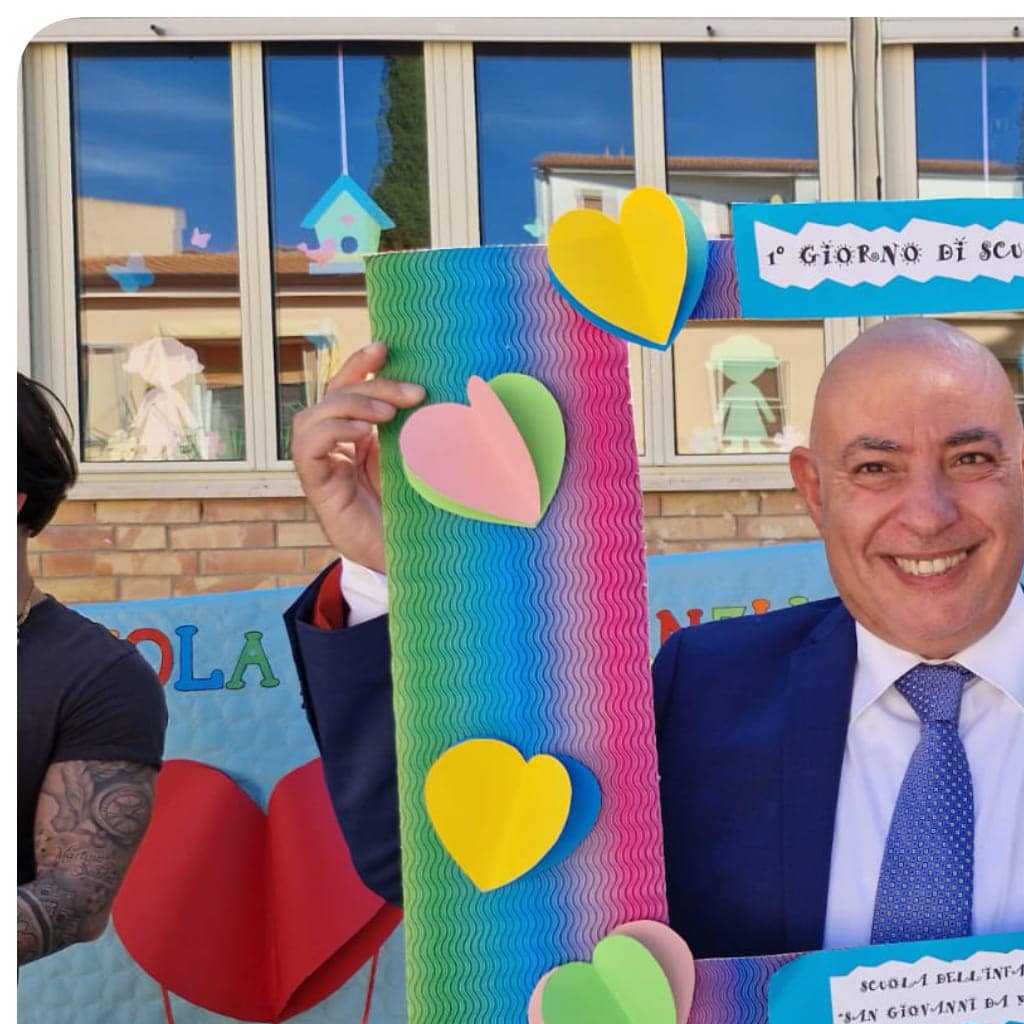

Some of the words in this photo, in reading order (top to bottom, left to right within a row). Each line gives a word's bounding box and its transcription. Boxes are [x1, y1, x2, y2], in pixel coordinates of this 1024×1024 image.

[799, 240, 922, 267] GIORNO
[937, 237, 967, 262] DI
[859, 973, 929, 993] SCUOLA
[886, 997, 978, 1019] GIOVANNI
[984, 994, 1008, 1010] DA
